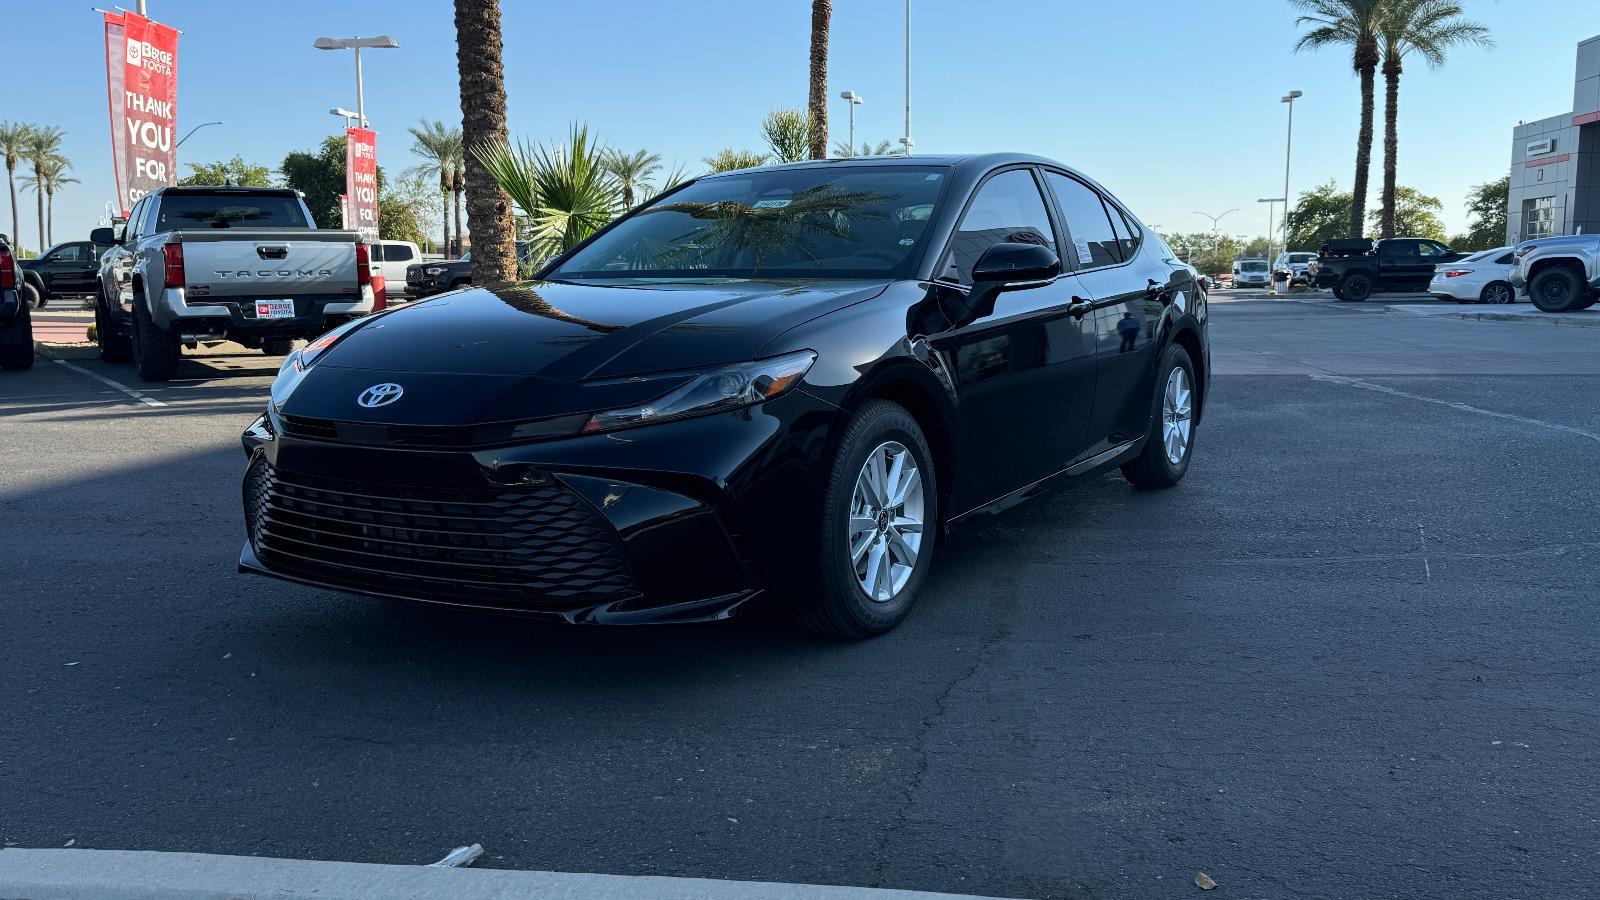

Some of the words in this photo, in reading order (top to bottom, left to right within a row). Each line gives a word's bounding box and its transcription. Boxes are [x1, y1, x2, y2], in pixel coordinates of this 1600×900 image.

[142, 59, 171, 77] TOOTA
[126, 91, 172, 119] THANK
[127, 117, 171, 153] YOU
[136, 157, 167, 183] FOR
[356, 187, 374, 203] YOU
[214, 269, 333, 278] TACOMA
[269, 303, 292, 311] BERGE
